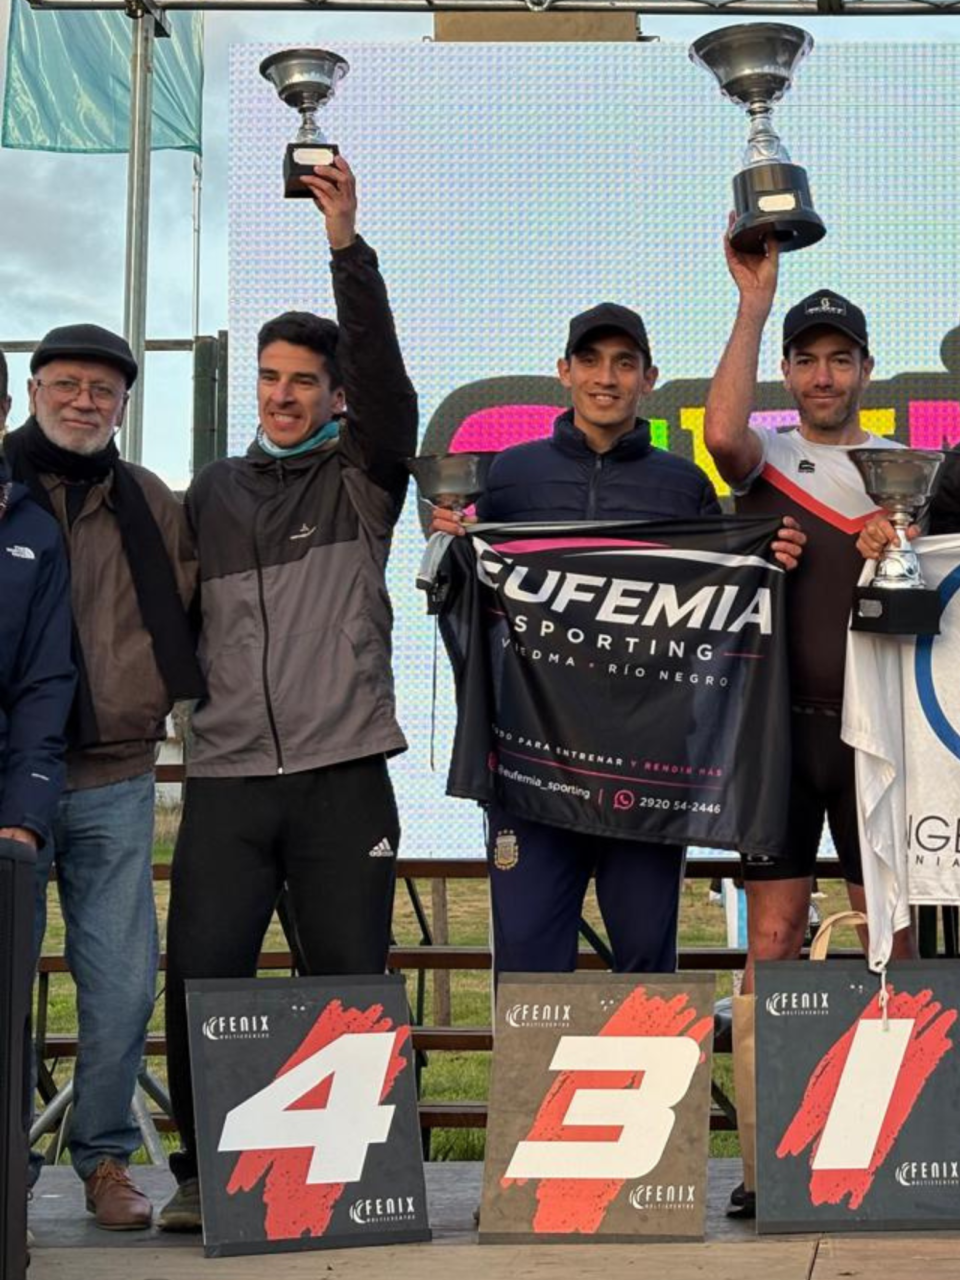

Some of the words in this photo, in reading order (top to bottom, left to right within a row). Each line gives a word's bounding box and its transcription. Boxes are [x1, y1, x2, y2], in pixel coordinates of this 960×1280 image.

[476, 550, 772, 635] EUFEMIA
[514, 615, 713, 661] SPORTING
[501, 638, 575, 667] VIEDMA
[609, 663, 645, 677] RÍO
[659, 670, 728, 687] NEGRO
[518, 736, 550, 751] PARA
[556, 747, 623, 766] ENTRENAR
[639, 797, 670, 810] 2920
[673, 801, 721, 814] 54-2446
[781, 992, 829, 1009] FENIX
[522, 1004, 571, 1021] FENIX
[218, 1016, 269, 1033] FENIX
[217, 1032, 396, 1184] 4
[504, 1036, 700, 1179] 3
[911, 1162, 958, 1179] FENIX
[645, 1185, 695, 1202] FENIX
[365, 1196, 415, 1216] FENIX
